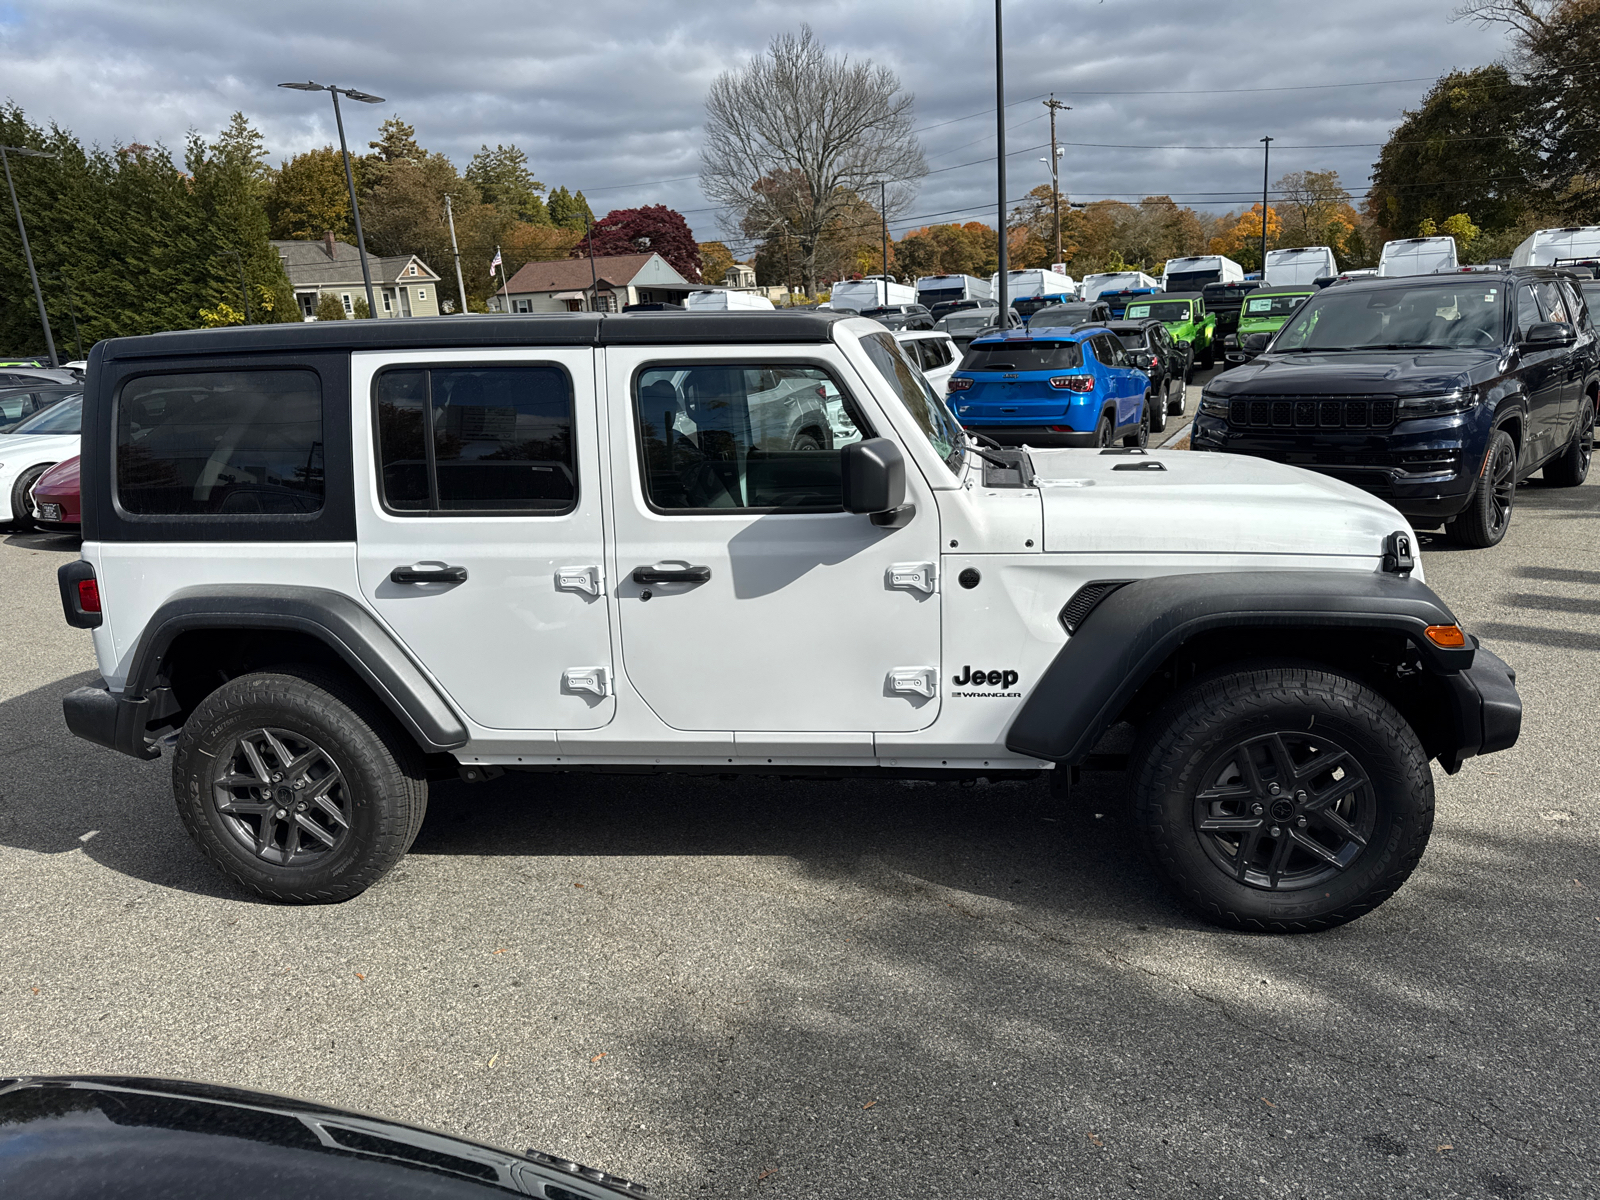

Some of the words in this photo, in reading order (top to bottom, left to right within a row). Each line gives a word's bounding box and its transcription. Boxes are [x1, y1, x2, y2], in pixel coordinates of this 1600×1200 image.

[953, 665, 1019, 689] Jeep
[210, 714, 242, 738] 245/75R17
[189, 780, 210, 827] HTX2
[332, 845, 361, 878] All-Weather
[1345, 823, 1402, 897] ROADIAN
